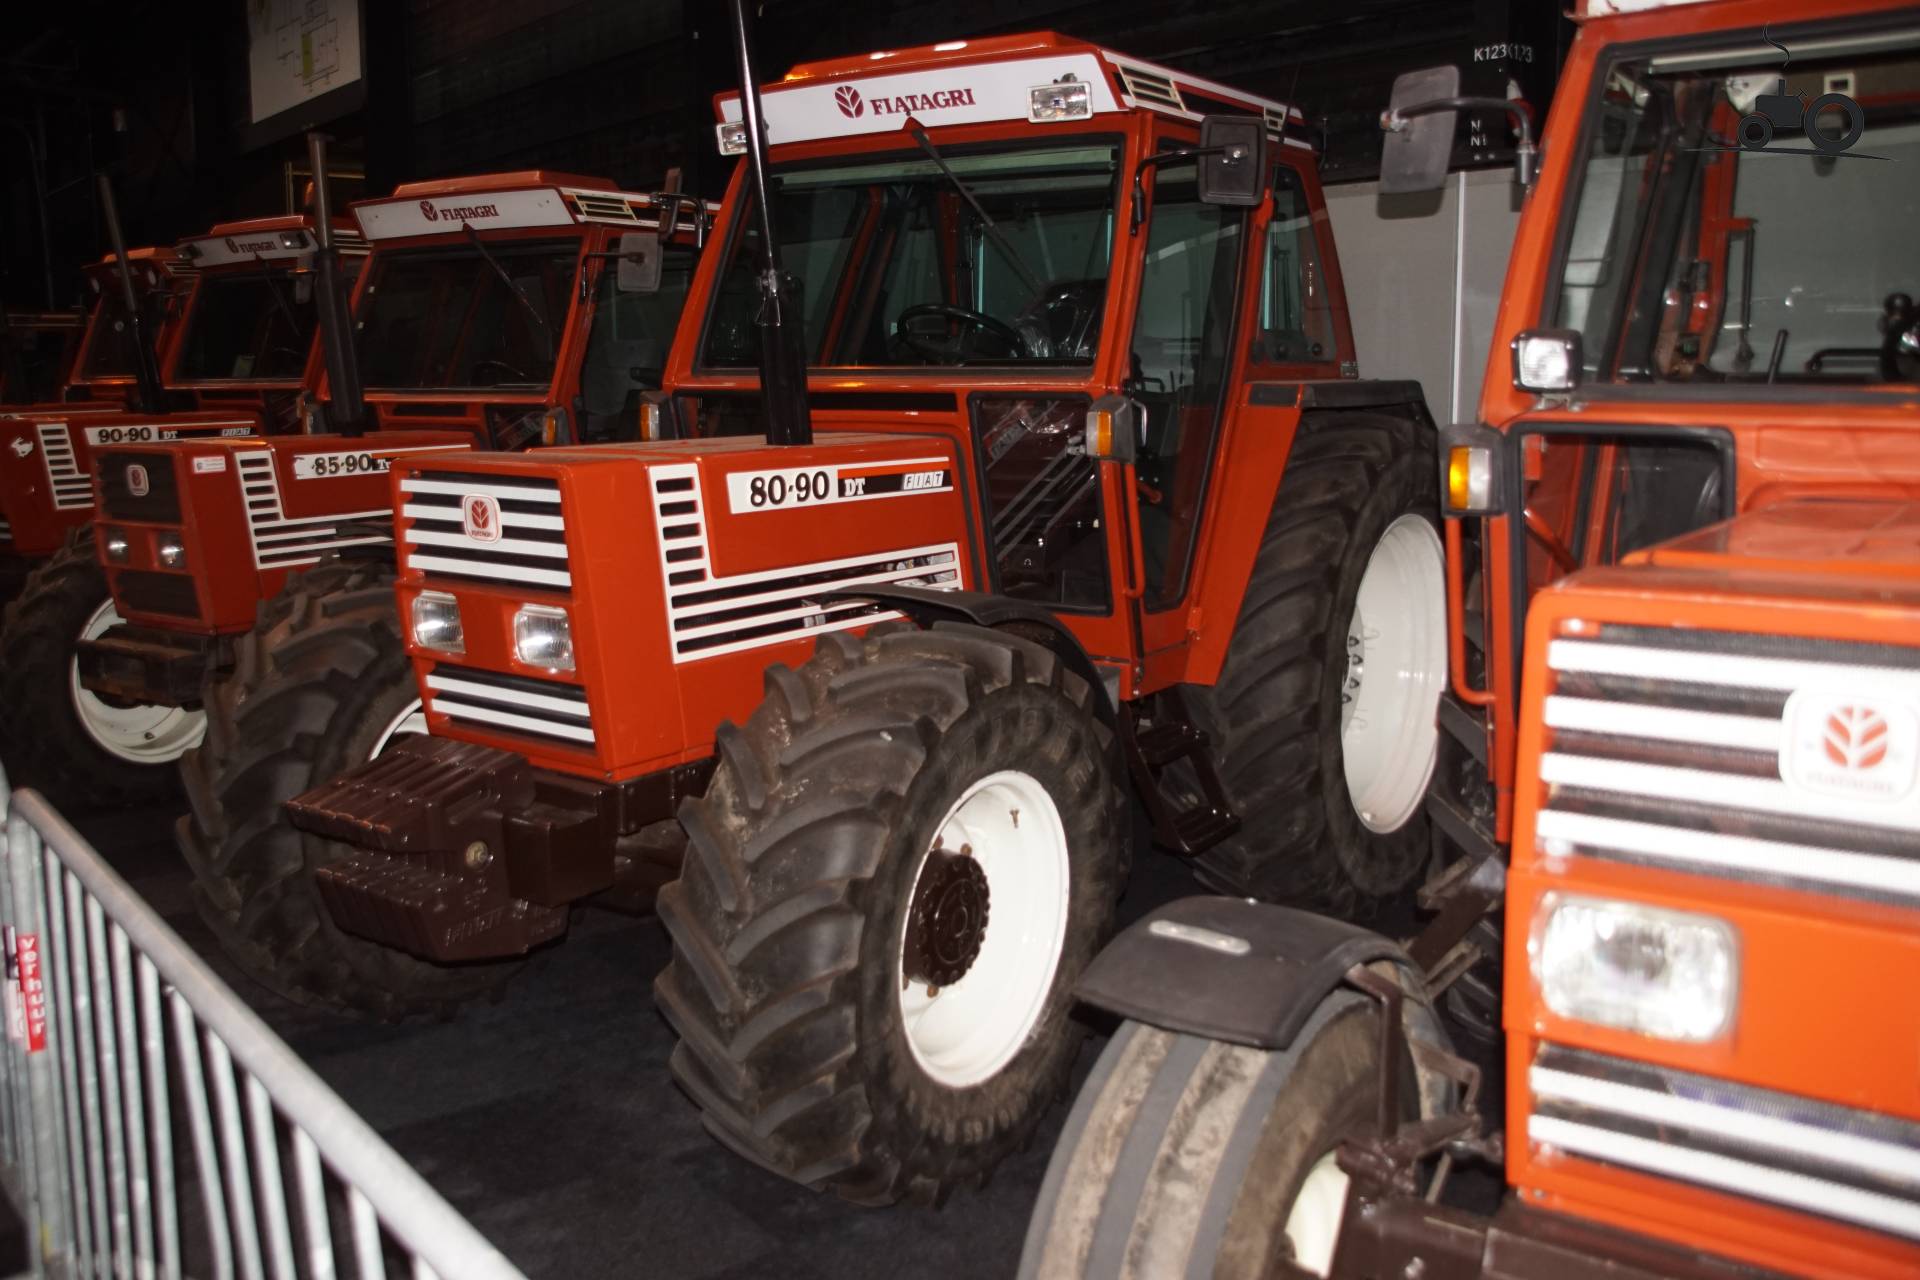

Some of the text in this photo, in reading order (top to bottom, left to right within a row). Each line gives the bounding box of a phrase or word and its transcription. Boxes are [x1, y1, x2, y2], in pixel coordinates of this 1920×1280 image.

[1474, 44, 1507, 62] K123
[870, 88, 976, 116] FIATAGRI
[440, 204, 499, 221] FIATAGRI
[163, 430, 178, 440] DT
[844, 477, 866, 497] DT
[904, 471, 944, 490] FIAT
[21, 936, 45, 1035] verhuur
